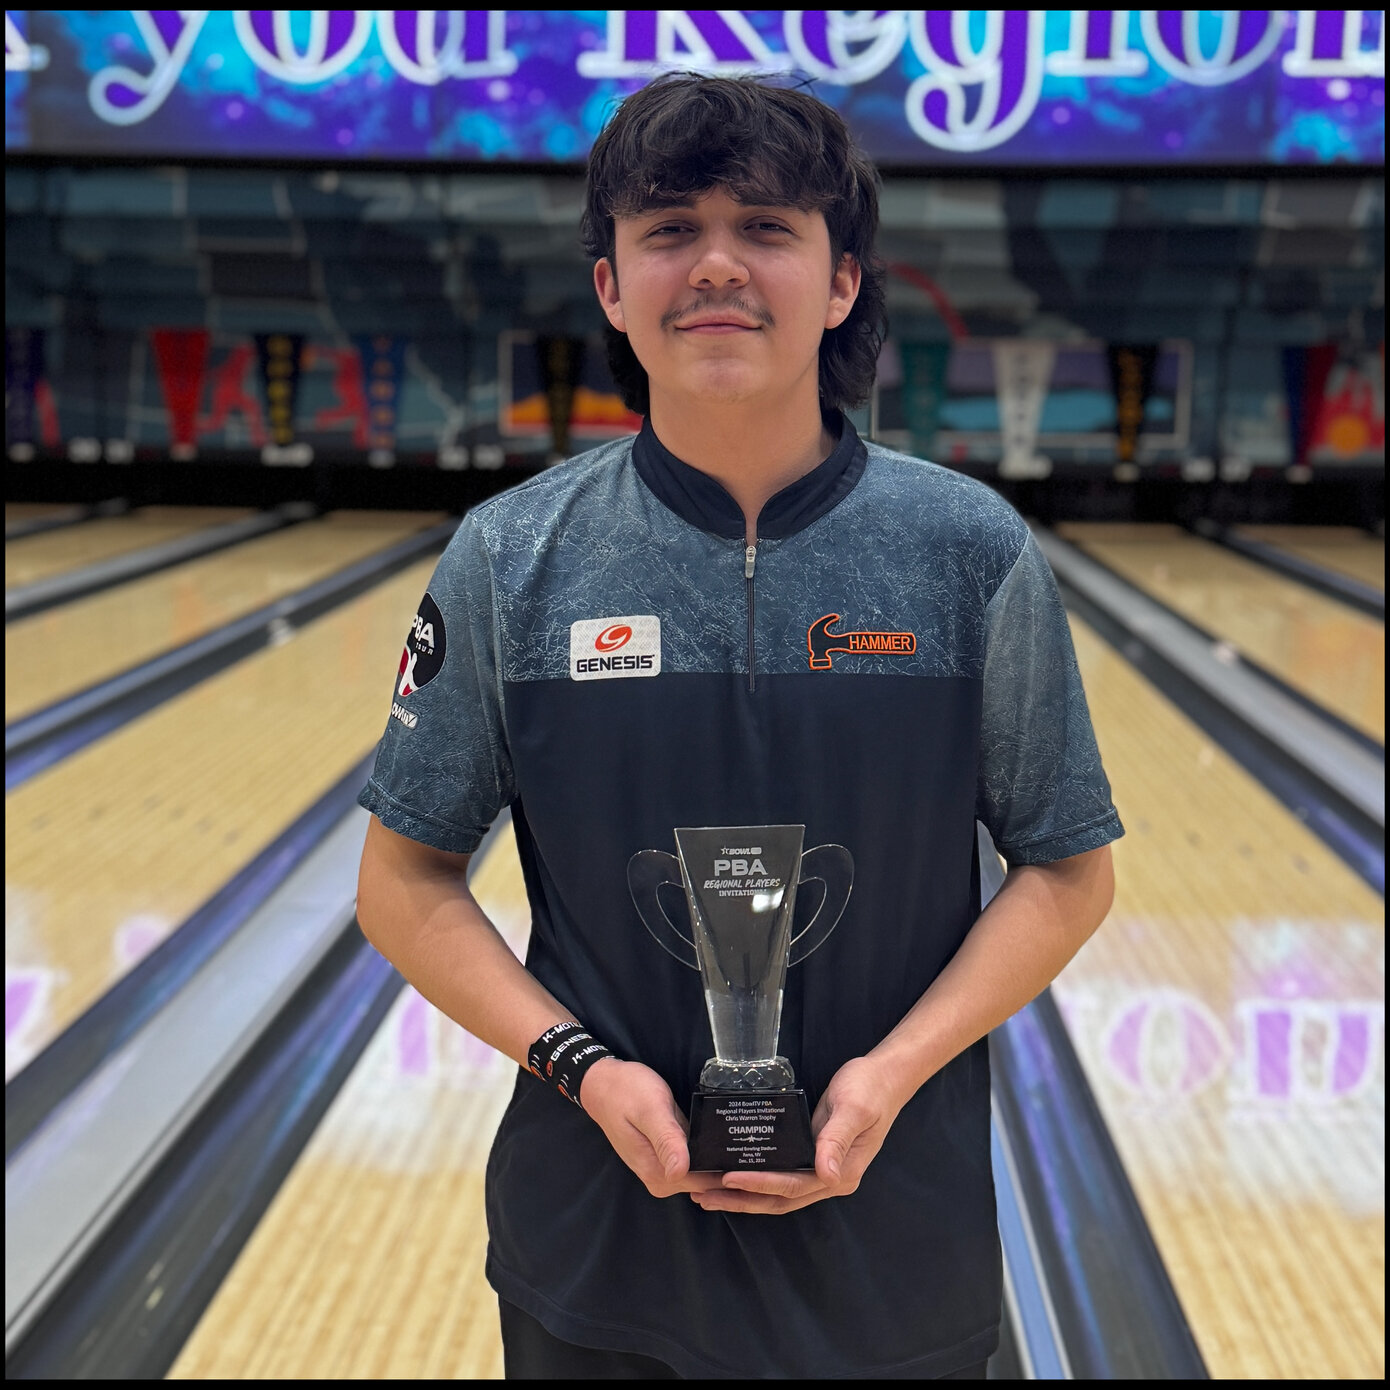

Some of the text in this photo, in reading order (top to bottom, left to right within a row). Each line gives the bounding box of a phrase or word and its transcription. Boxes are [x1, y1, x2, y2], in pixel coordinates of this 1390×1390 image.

[849, 635, 911, 650] HAMMER
[576, 655, 653, 673] GENESIS
[714, 859, 768, 876] PBA
[704, 878, 780, 889] REGIONAL PLAYERS
[728, 1125, 774, 1134] CHAMPION
